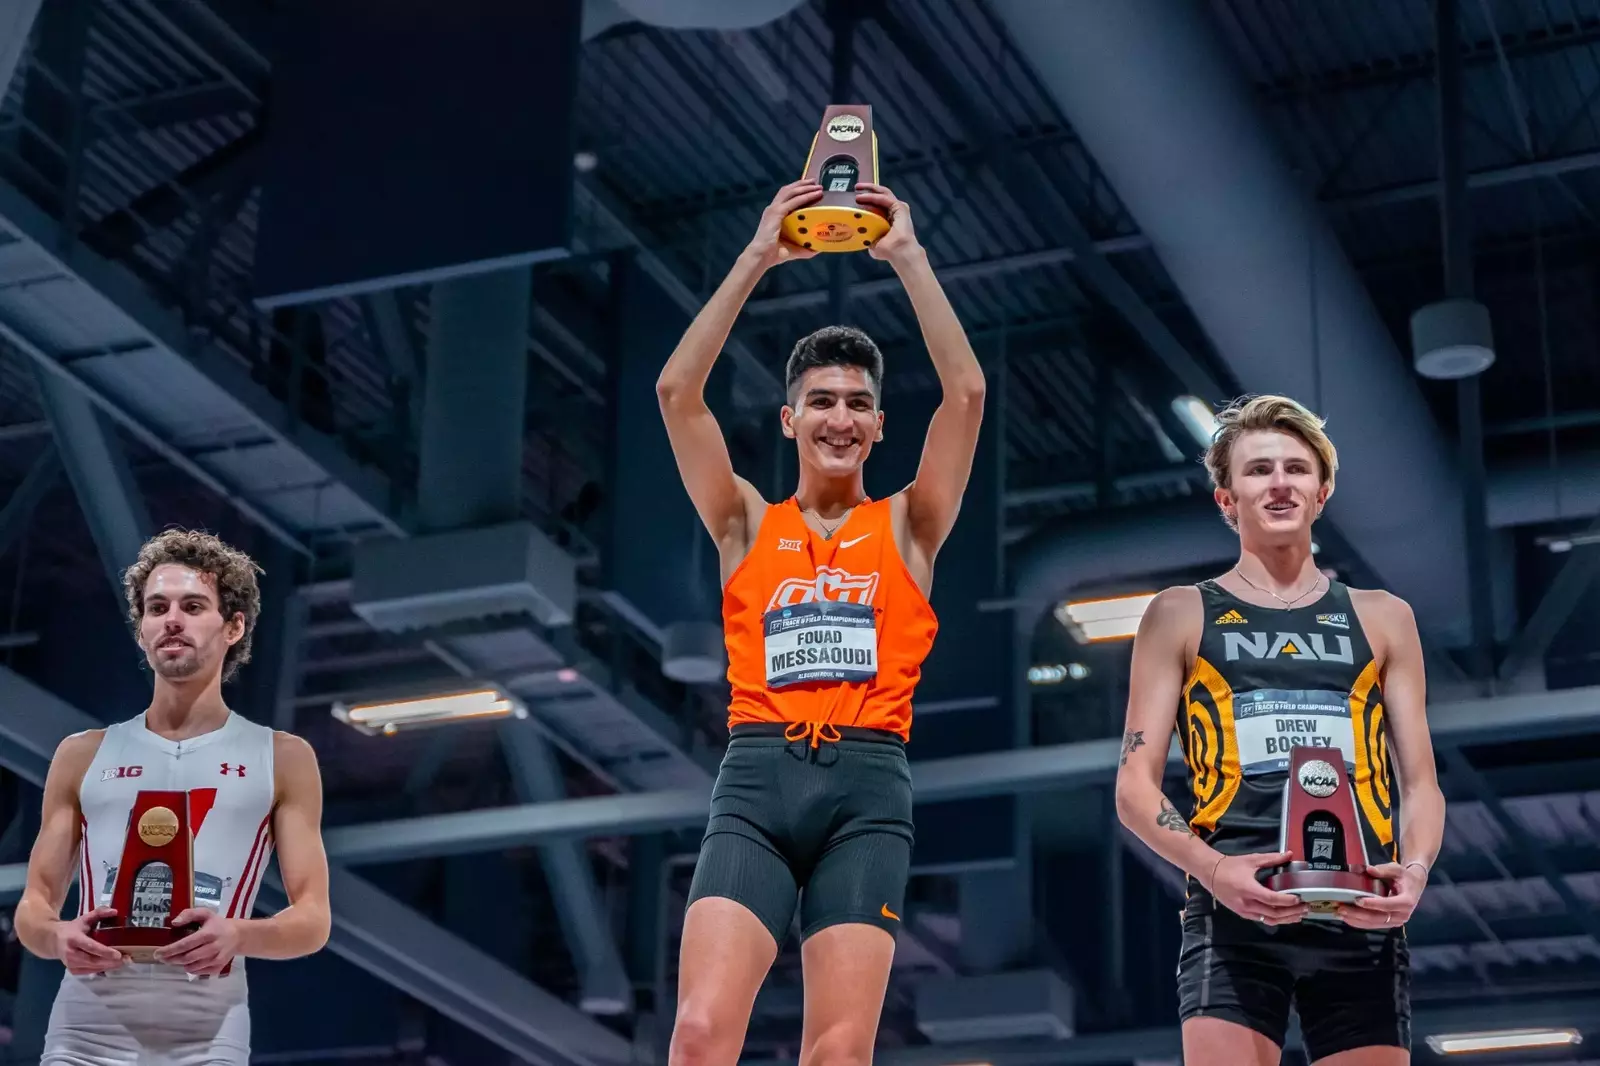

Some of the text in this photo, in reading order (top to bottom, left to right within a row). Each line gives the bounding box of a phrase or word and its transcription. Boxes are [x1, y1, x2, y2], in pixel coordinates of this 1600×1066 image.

[829, 125, 862, 134] NCAA
[782, 618, 800, 627] TRACK
[804, 615, 821, 624] FIELD
[822, 615, 870, 624] CHAMPIONSHIPS
[797, 630, 843, 646] FOUAD
[1221, 631, 1354, 665] NAU
[771, 647, 872, 673] MESSAOUDI
[1297, 704, 1346, 713] CHAMPIONSHIPS
[1275, 719, 1317, 732] DREW
[1302, 775, 1337, 788] NCAA
